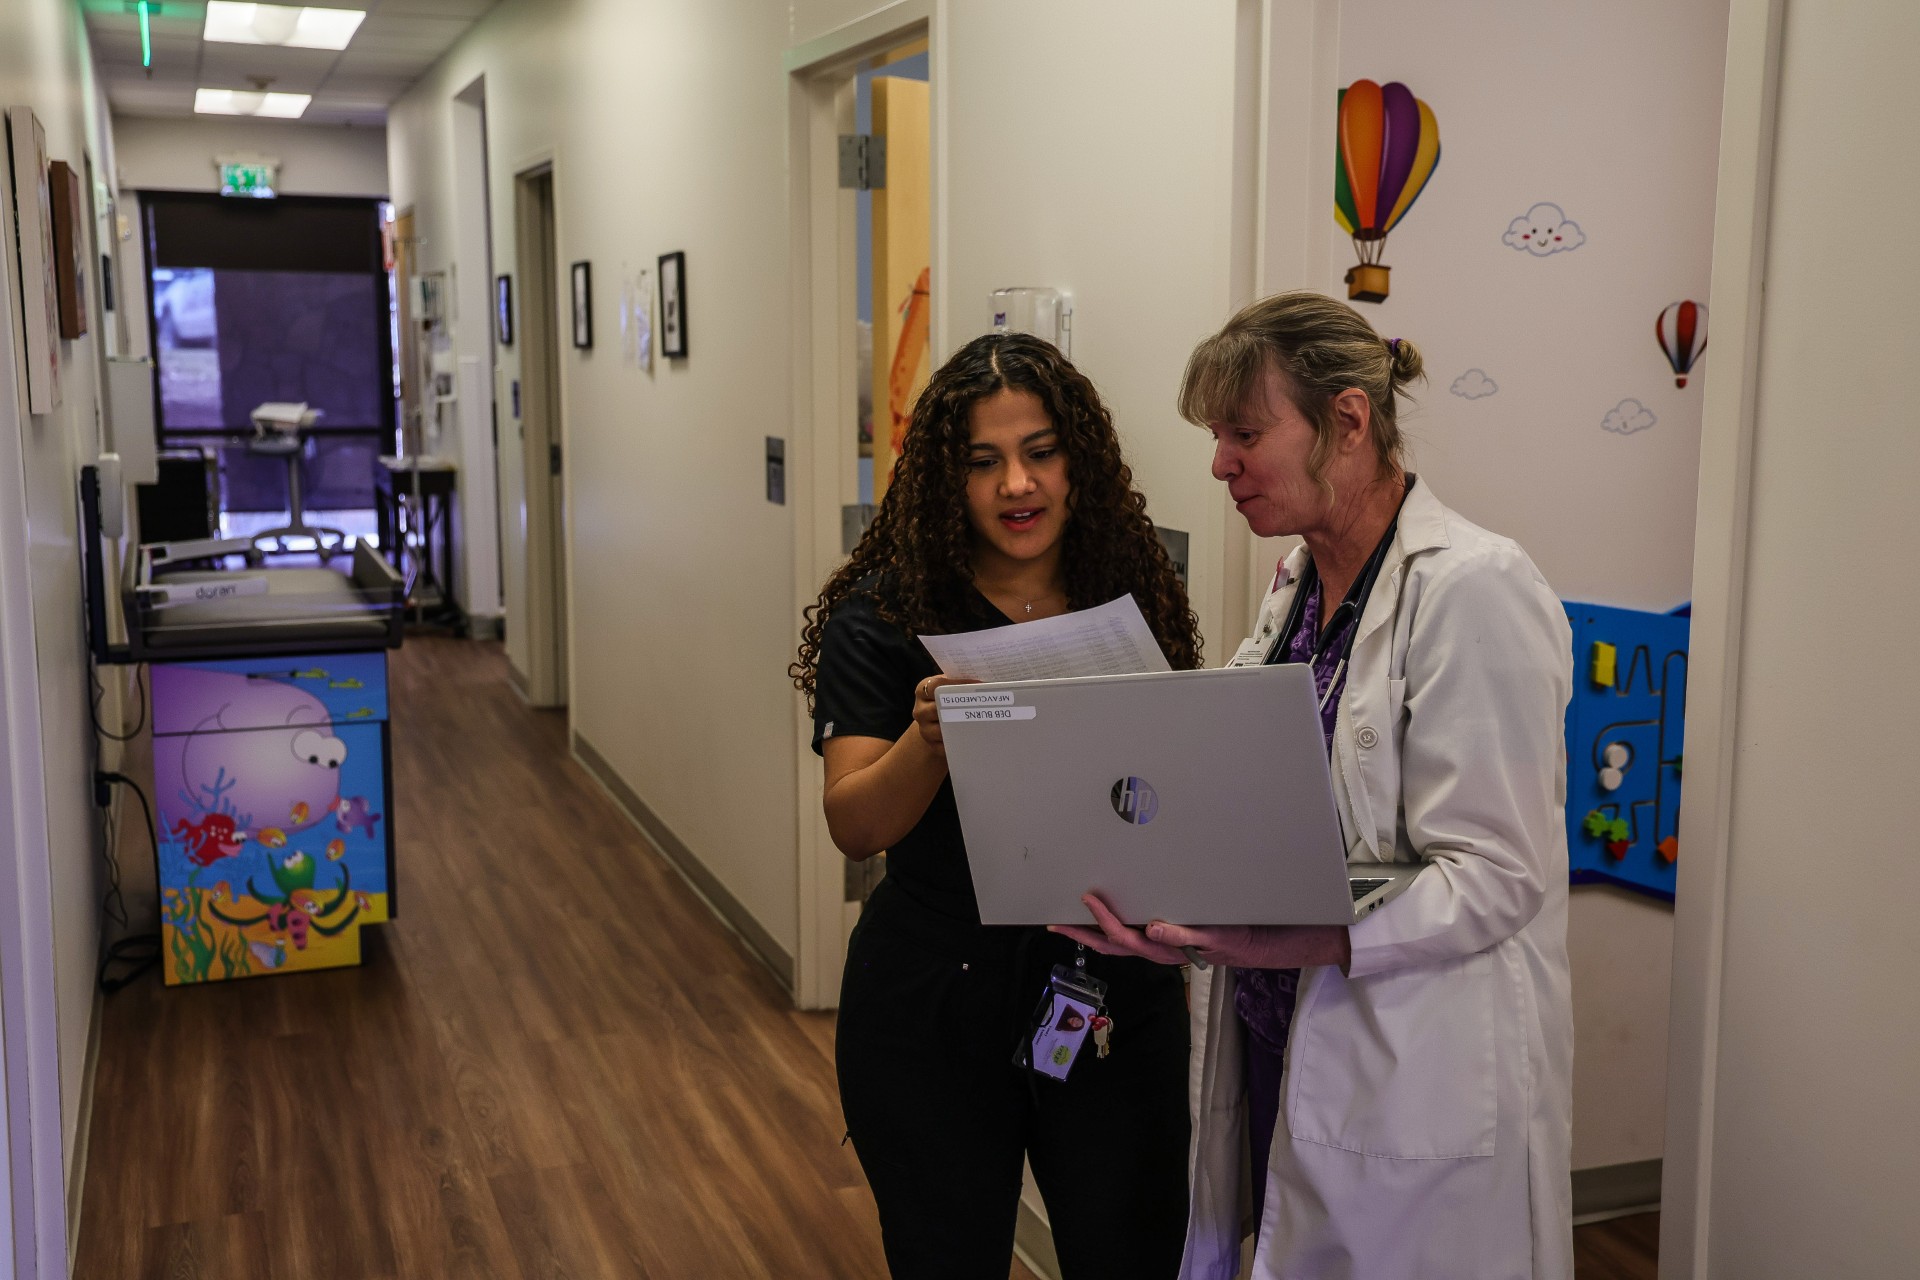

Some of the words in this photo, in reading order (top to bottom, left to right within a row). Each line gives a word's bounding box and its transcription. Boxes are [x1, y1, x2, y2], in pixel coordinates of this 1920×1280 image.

[964, 711, 993, 719] BURNS
[994, 709, 1011, 718] DEB
[1118, 777, 1151, 824] hp
